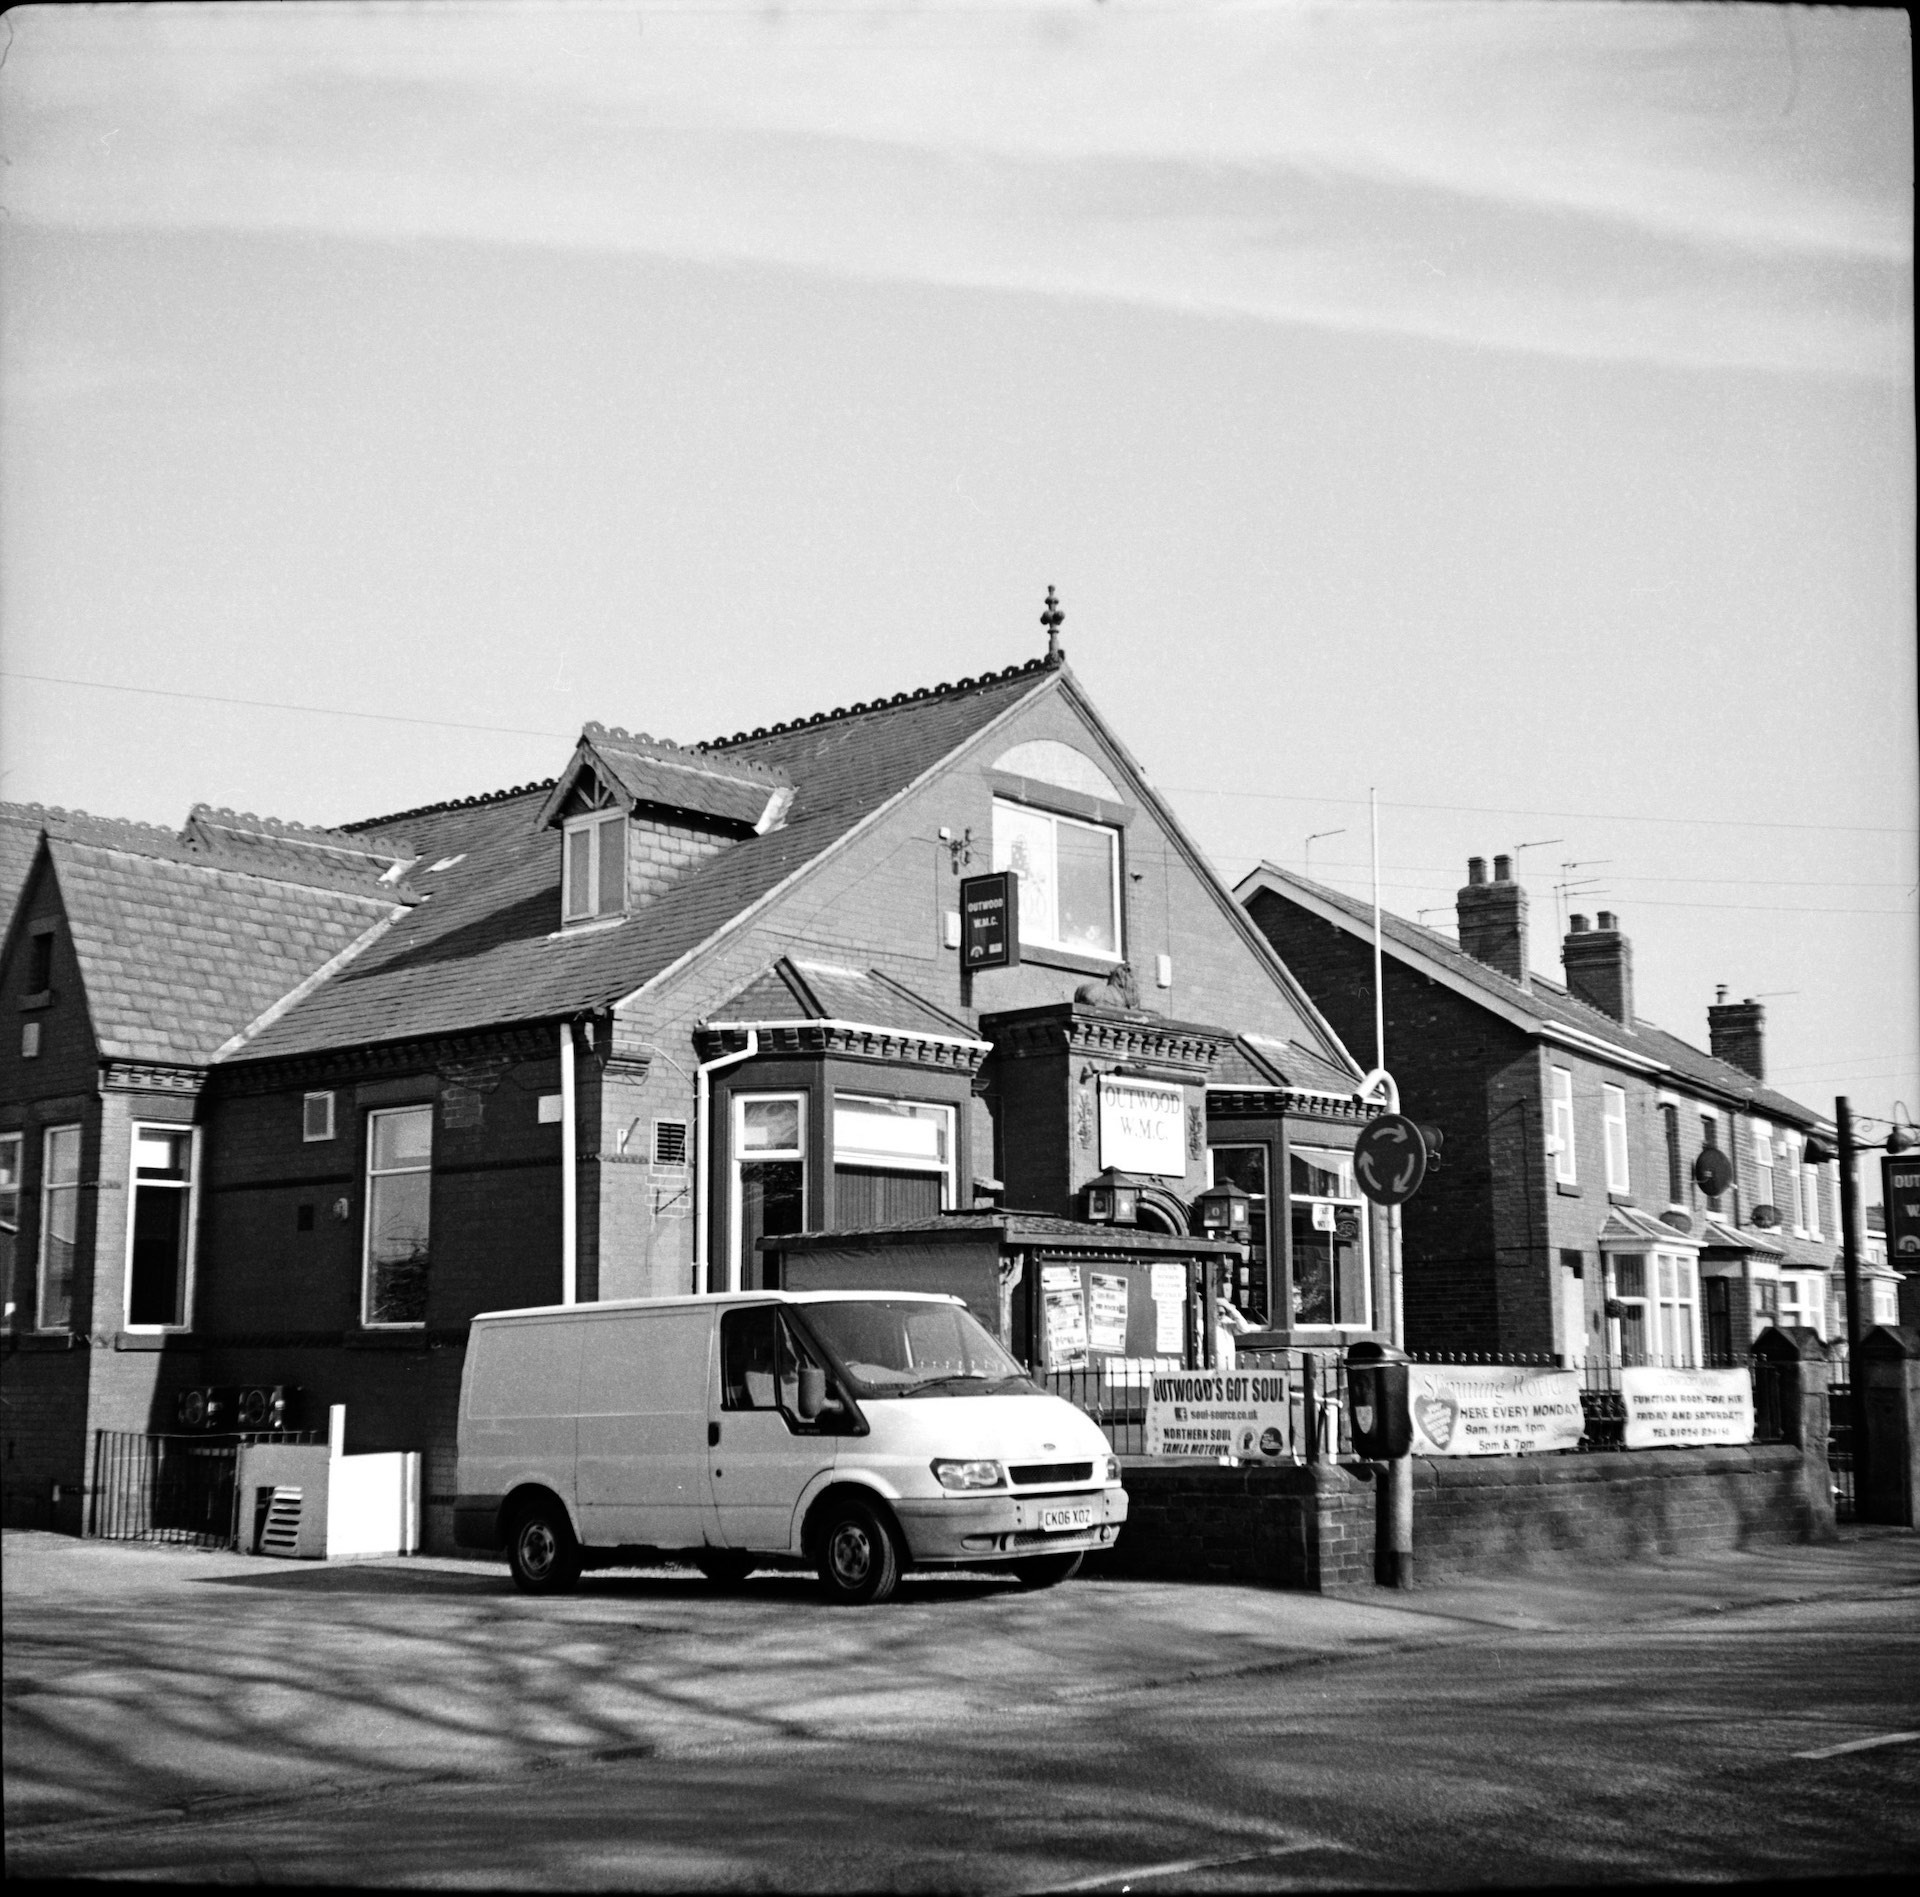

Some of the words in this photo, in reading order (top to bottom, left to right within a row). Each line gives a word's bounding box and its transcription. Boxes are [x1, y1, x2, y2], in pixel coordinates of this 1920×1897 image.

[967, 897, 1003, 912] OUTWOOD
[1105, 1085, 1180, 1114] OUTWOOD
[1120, 1116, 1168, 1141] W.M.C.
[1153, 1377, 1223, 1402] OUTWOOD'S
[1226, 1377, 1249, 1402] GOT
[1252, 1377, 1284, 1402] SOUL
[1513, 1375, 1563, 1397] World
[1632, 1394, 1677, 1405] FUNCTION
[1705, 1394, 1726, 1404] FOR
[1460, 1406, 1490, 1419] HERE
[1493, 1405, 1528, 1419] EVERY
[1533, 1403, 1580, 1417] MONDAY
[1672, 1411, 1692, 1420] AND
[1163, 1427, 1209, 1441] NORTHERN
[1210, 1429, 1231, 1441] SOUL
[1525, 1423, 1546, 1437] 1pm
[1162, 1443, 1189, 1455] TAMLA
[1190, 1443, 1230, 1456] MOTOWN
[1479, 1440, 1499, 1451] 5pm
[1503, 1439, 1510, 1449] &
[1515, 1439, 1535, 1451] 7pm
[1045, 1510, 1070, 1526] CK06
[1073, 1509, 1090, 1523] XOZ
